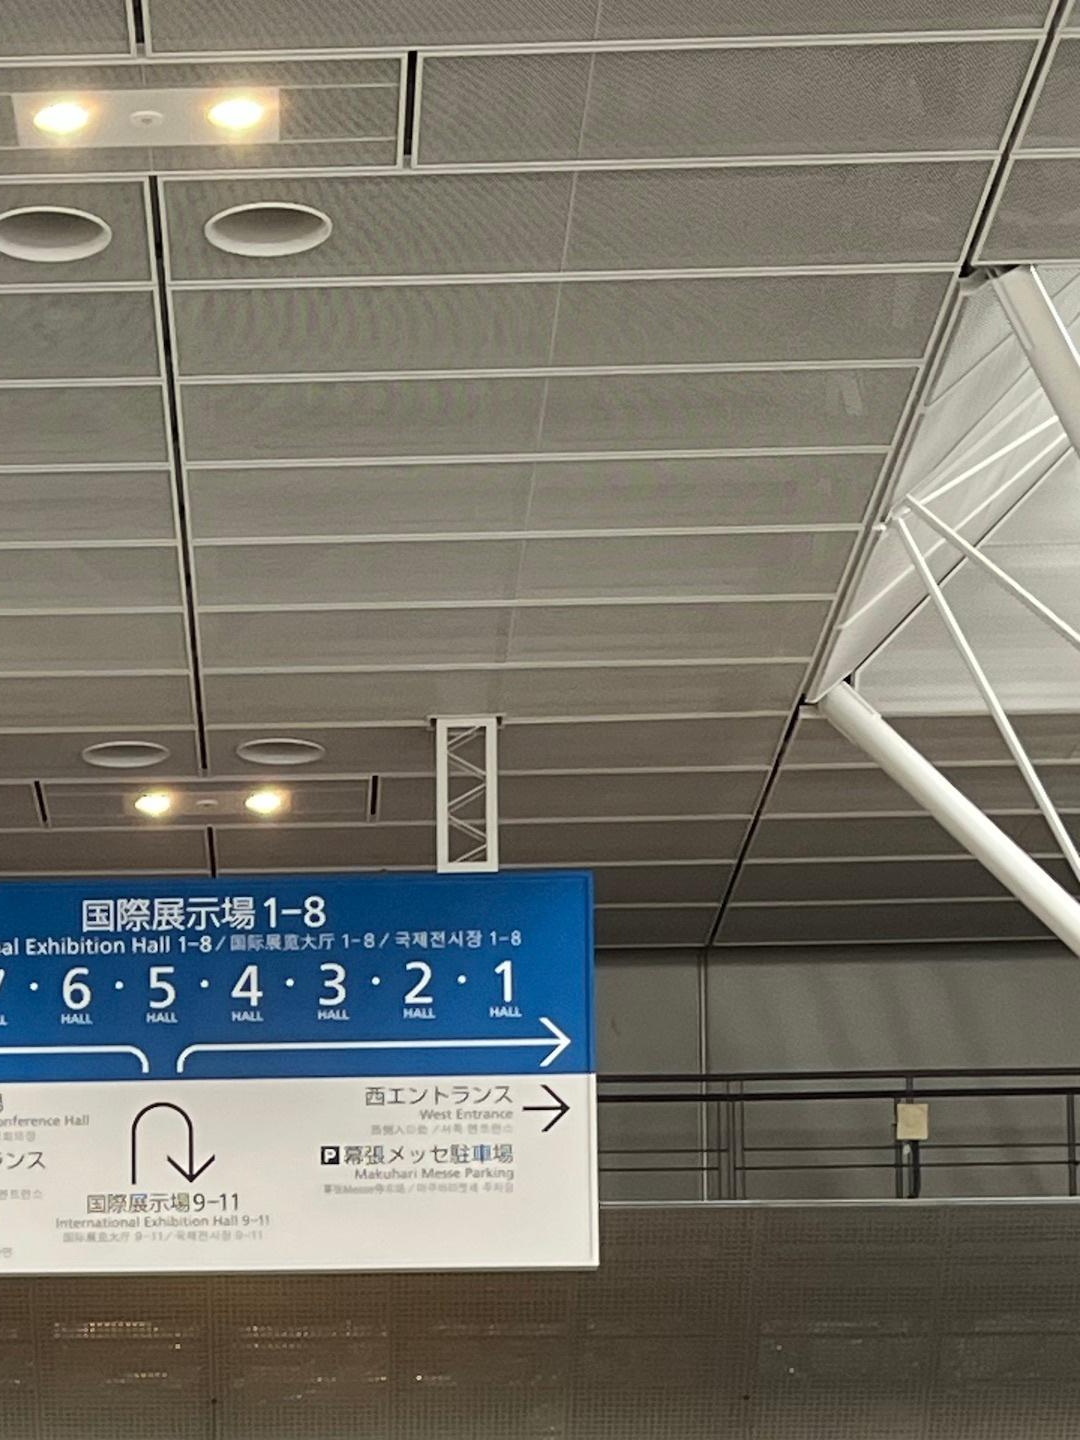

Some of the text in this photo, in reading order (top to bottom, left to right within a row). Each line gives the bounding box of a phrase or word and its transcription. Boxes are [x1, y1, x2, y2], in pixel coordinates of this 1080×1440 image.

[26, 936, 125, 956] Exhibition
[132, 935, 171, 954] Hall
[62, 967, 92, 1010] 6
[149, 966, 176, 1009] 5
[230, 964, 263, 1007] 4
[319, 963, 347, 1006] 3
[404, 961, 433, 1004] 2
[494, 959, 513, 1003] 1
[61, 1013, 93, 1025] HALL
[146, 1012, 178, 1024] HALL
[231, 1010, 264, 1022] HALL
[317, 1009, 350, 1020] HALL
[403, 1007, 436, 1019] HALL
[489, 1006, 522, 1018] HALL
[365, 1085, 513, 1106] 西エントランス
[64, 1114, 90, 1126] Hall
[419, 1108, 514, 1120] West Entrance
[344, 1144, 514, 1165] 幕張メッセ駐車場
[355, 1167, 515, 1181] Makuhari Messe Parking
[55, 1216, 141, 1229] International
[144, 1216, 209, 1228] Exhibition
[213, 1215, 238, 1227] Hall
